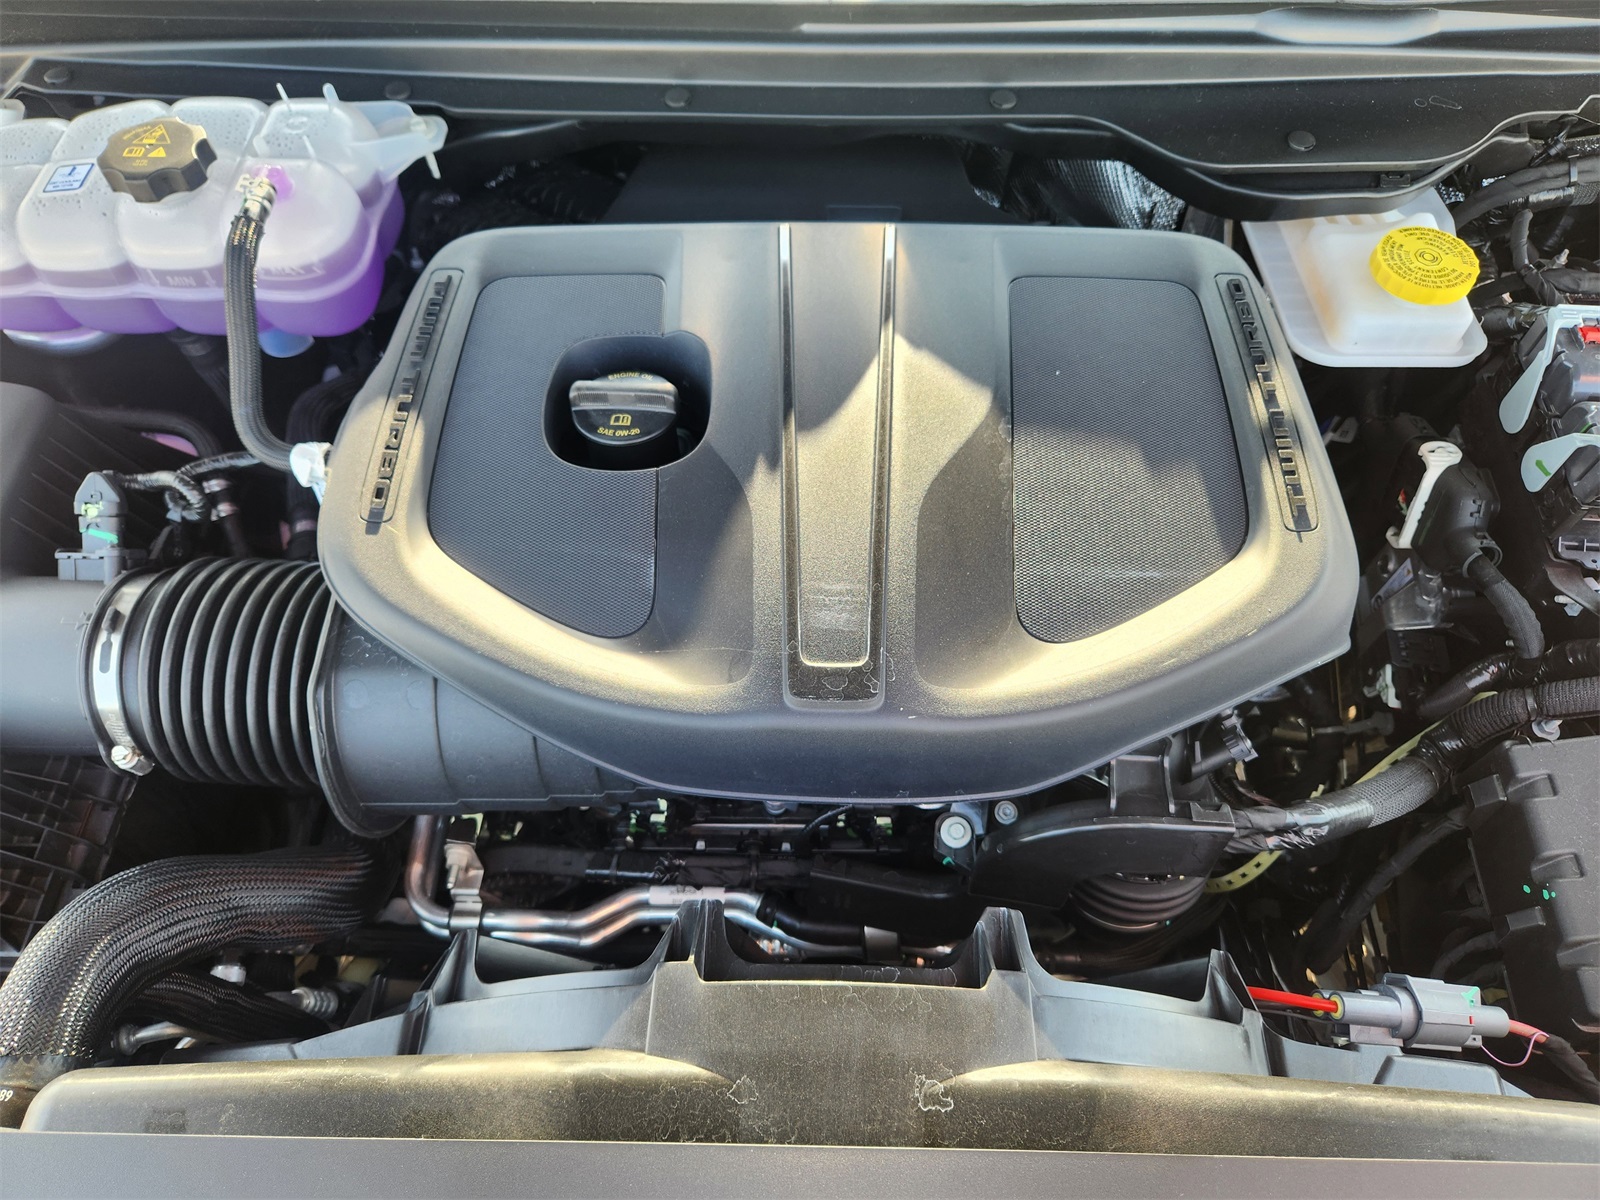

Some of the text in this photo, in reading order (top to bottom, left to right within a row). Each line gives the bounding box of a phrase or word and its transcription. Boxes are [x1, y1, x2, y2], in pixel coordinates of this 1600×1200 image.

[608, 372, 654, 381] ENGINE OIL
[1227, 278, 1307, 517] TWIN TURBO
[370, 368, 422, 510] TURBO
[597, 427, 614, 437] SAE
